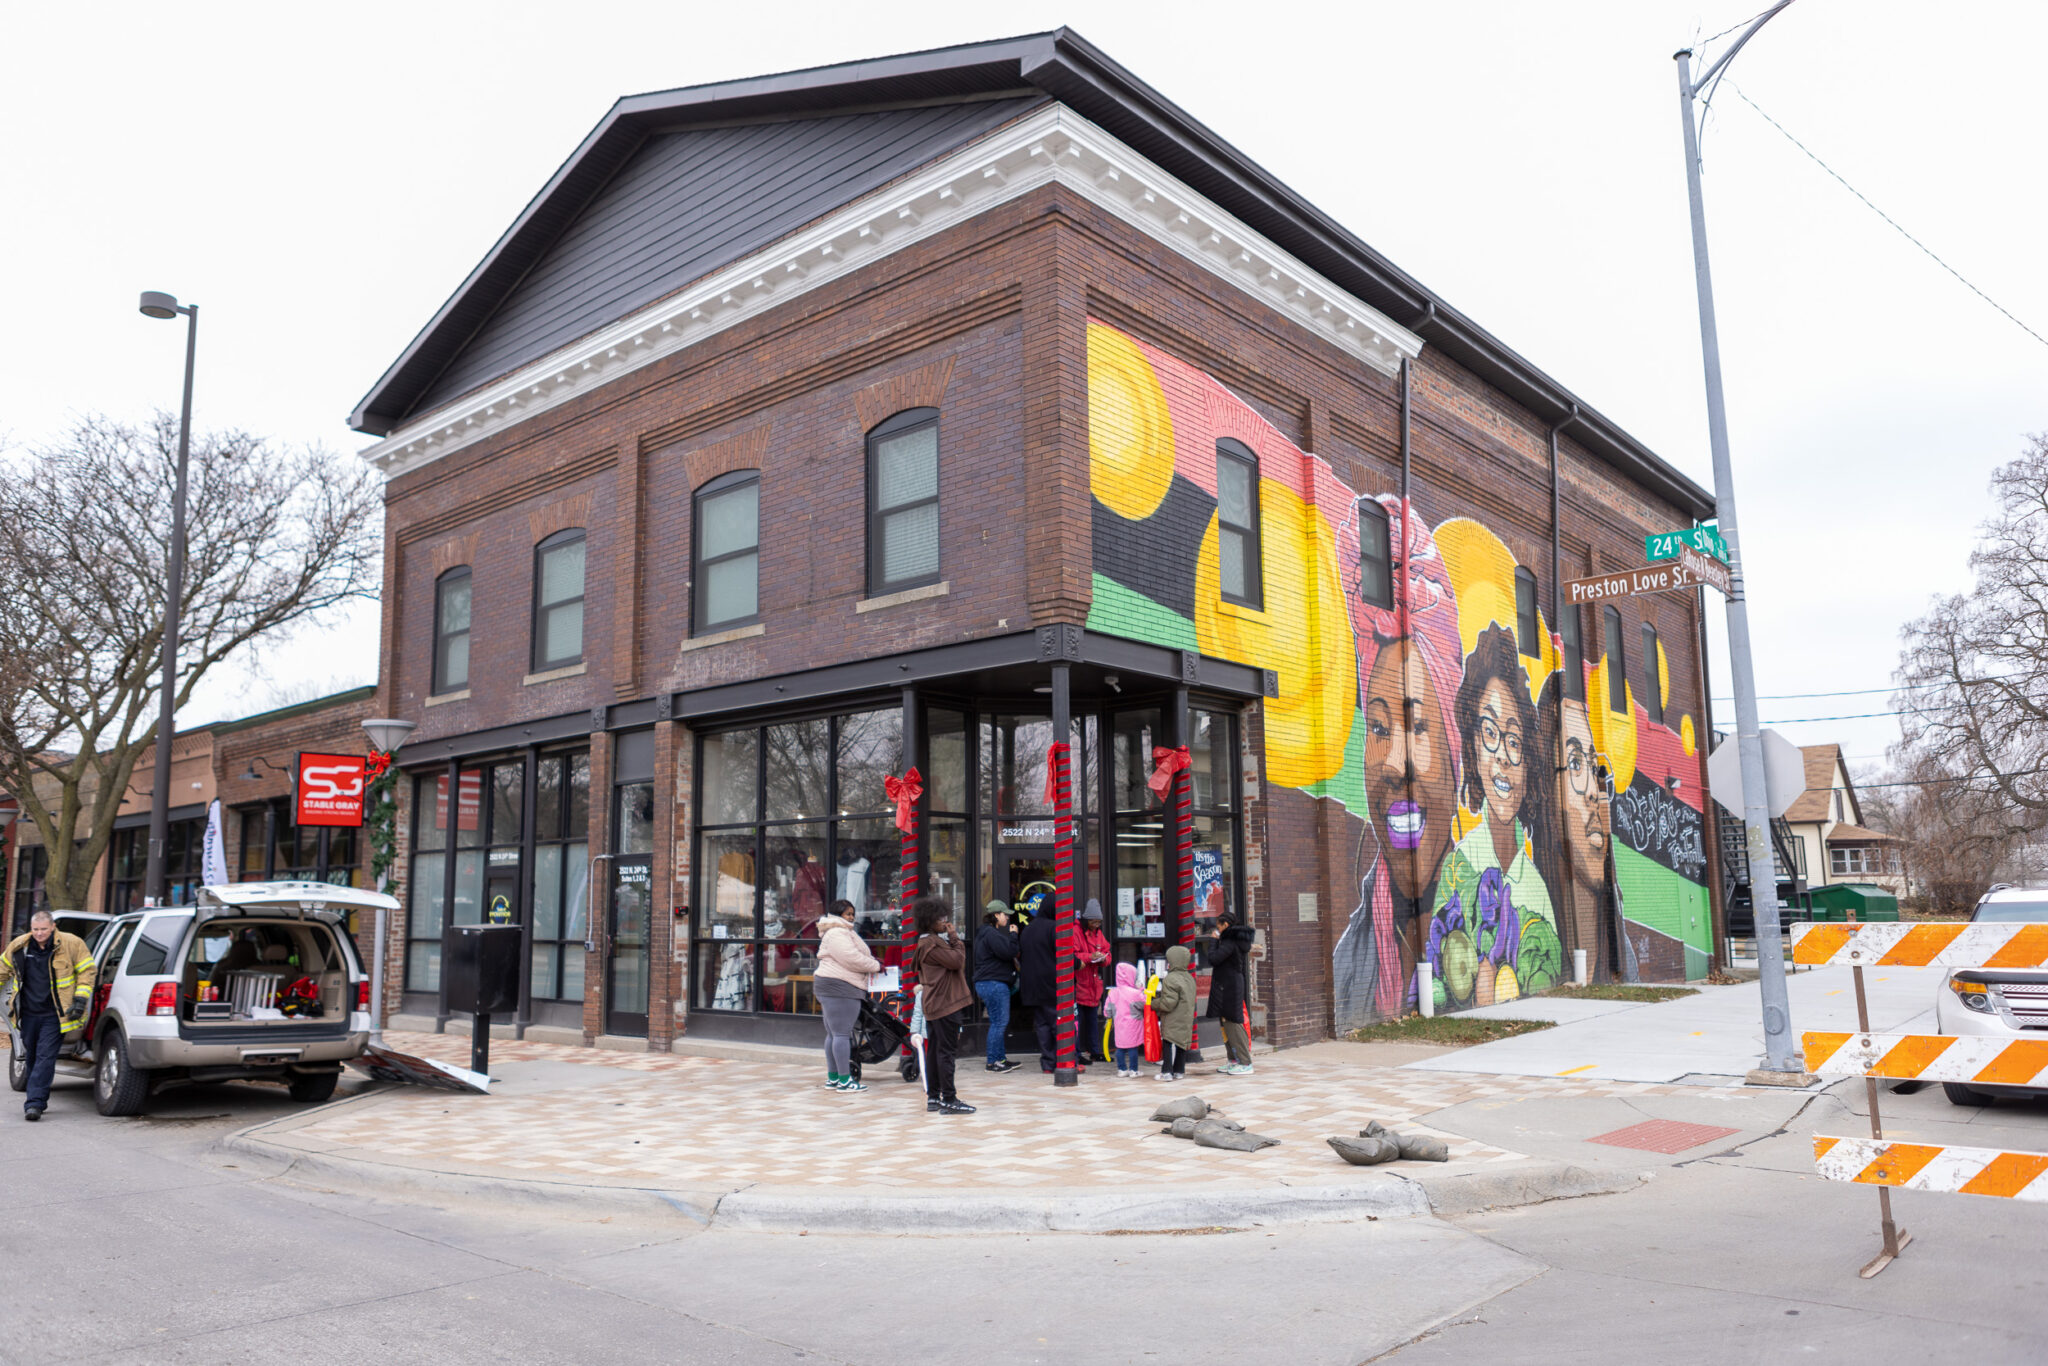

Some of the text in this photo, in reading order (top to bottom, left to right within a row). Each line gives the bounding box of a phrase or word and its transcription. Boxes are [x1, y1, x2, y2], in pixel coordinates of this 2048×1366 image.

[1653, 535, 1682, 556] 24th
[1572, 565, 1691, 601] Preston Love Sr.
[303, 800, 360, 810] STABLE GRAY
[1002, 828, 1024, 837] 2522
[1034, 828, 1050, 836] 24th
[1204, 853, 1216, 865] the
[1194, 864, 1223, 889] Season
